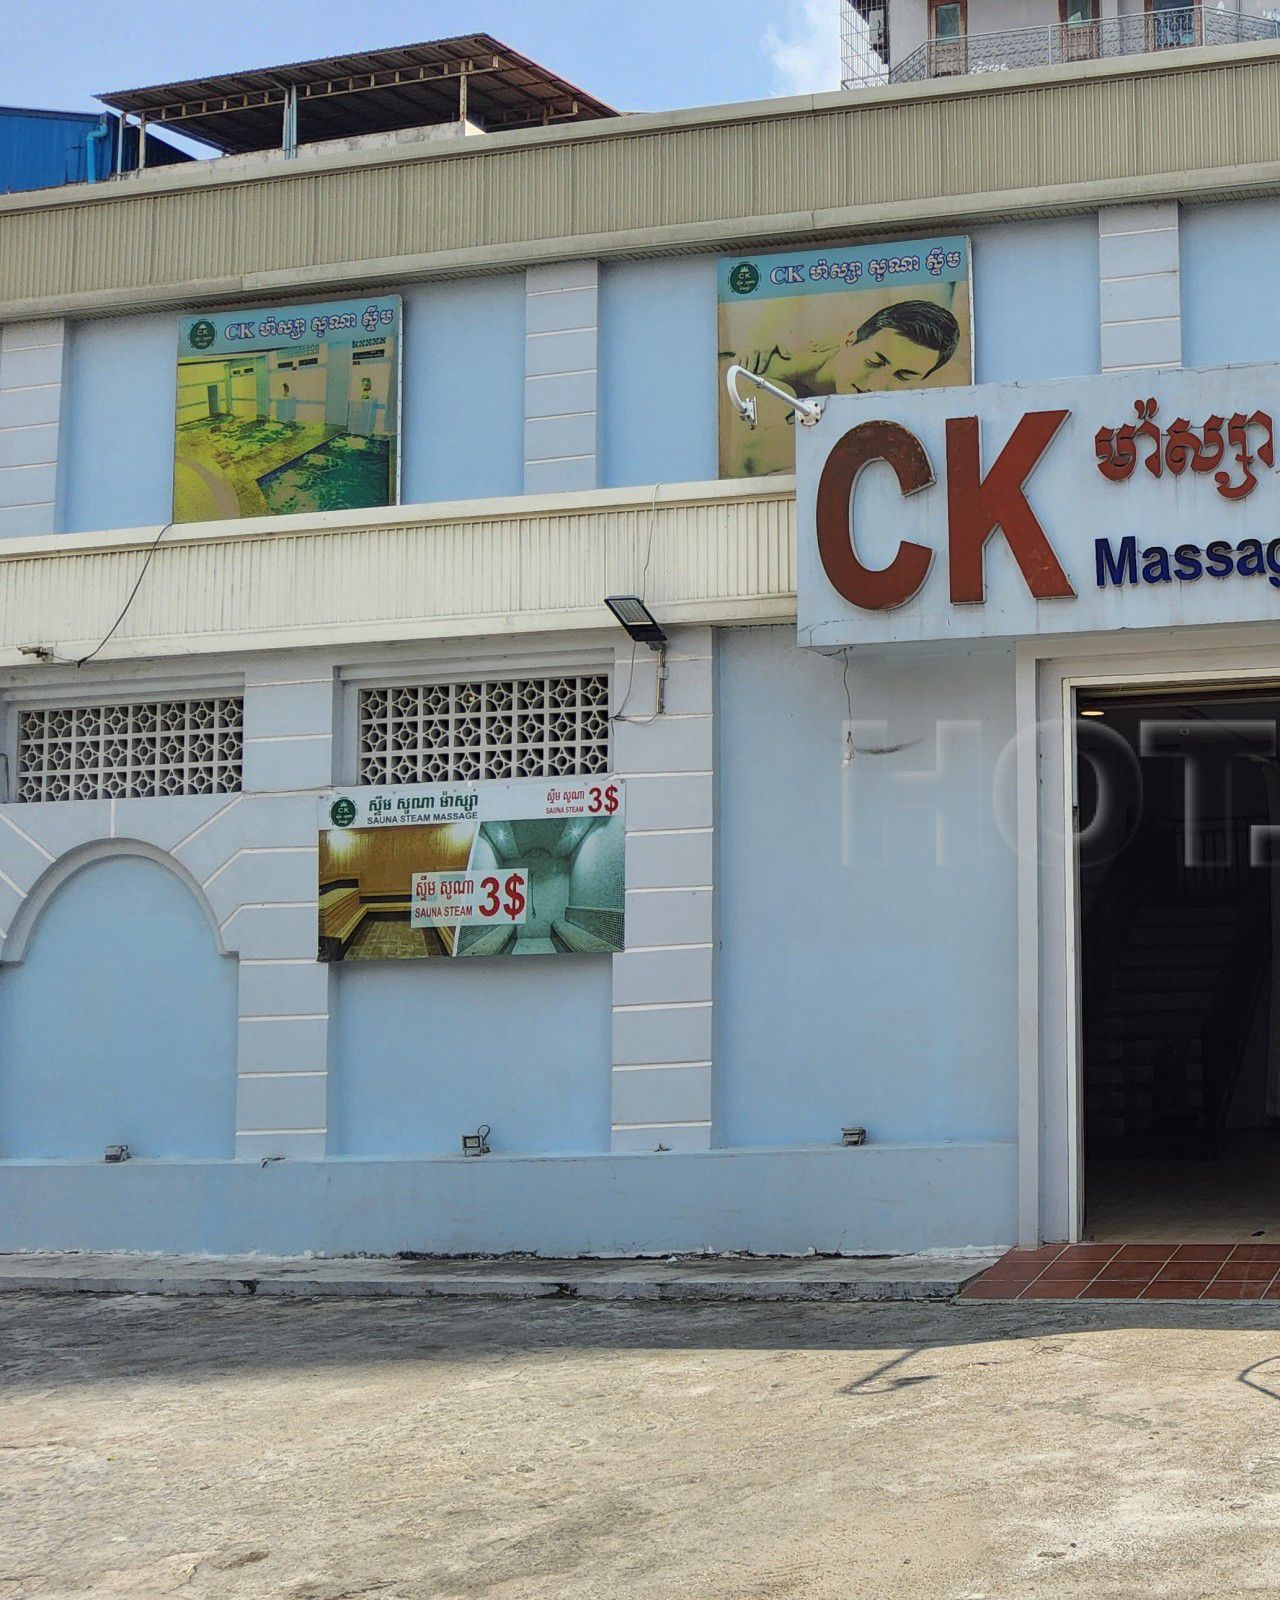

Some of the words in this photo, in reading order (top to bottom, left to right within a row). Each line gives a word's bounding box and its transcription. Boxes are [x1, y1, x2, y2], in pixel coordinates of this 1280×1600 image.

[770, 265, 805, 285] CK
[868, 255, 921, 283] សូណា
[224, 321, 255, 341] CK
[311, 312, 357, 338] សូណា
[816, 408, 1078, 611] CK
[397, 796, 435, 814] សូណា
[588, 784, 619, 815] 3$
[367, 815, 398, 825] SAUNA
[400, 814, 430, 823] STEAM
[433, 812, 478, 821] MASSAGE
[440, 880, 474, 900] សូណា
[479, 873, 525, 920] 3$
[415, 907, 441, 918] SAUNA
[444, 905, 473, 917] STEAM
